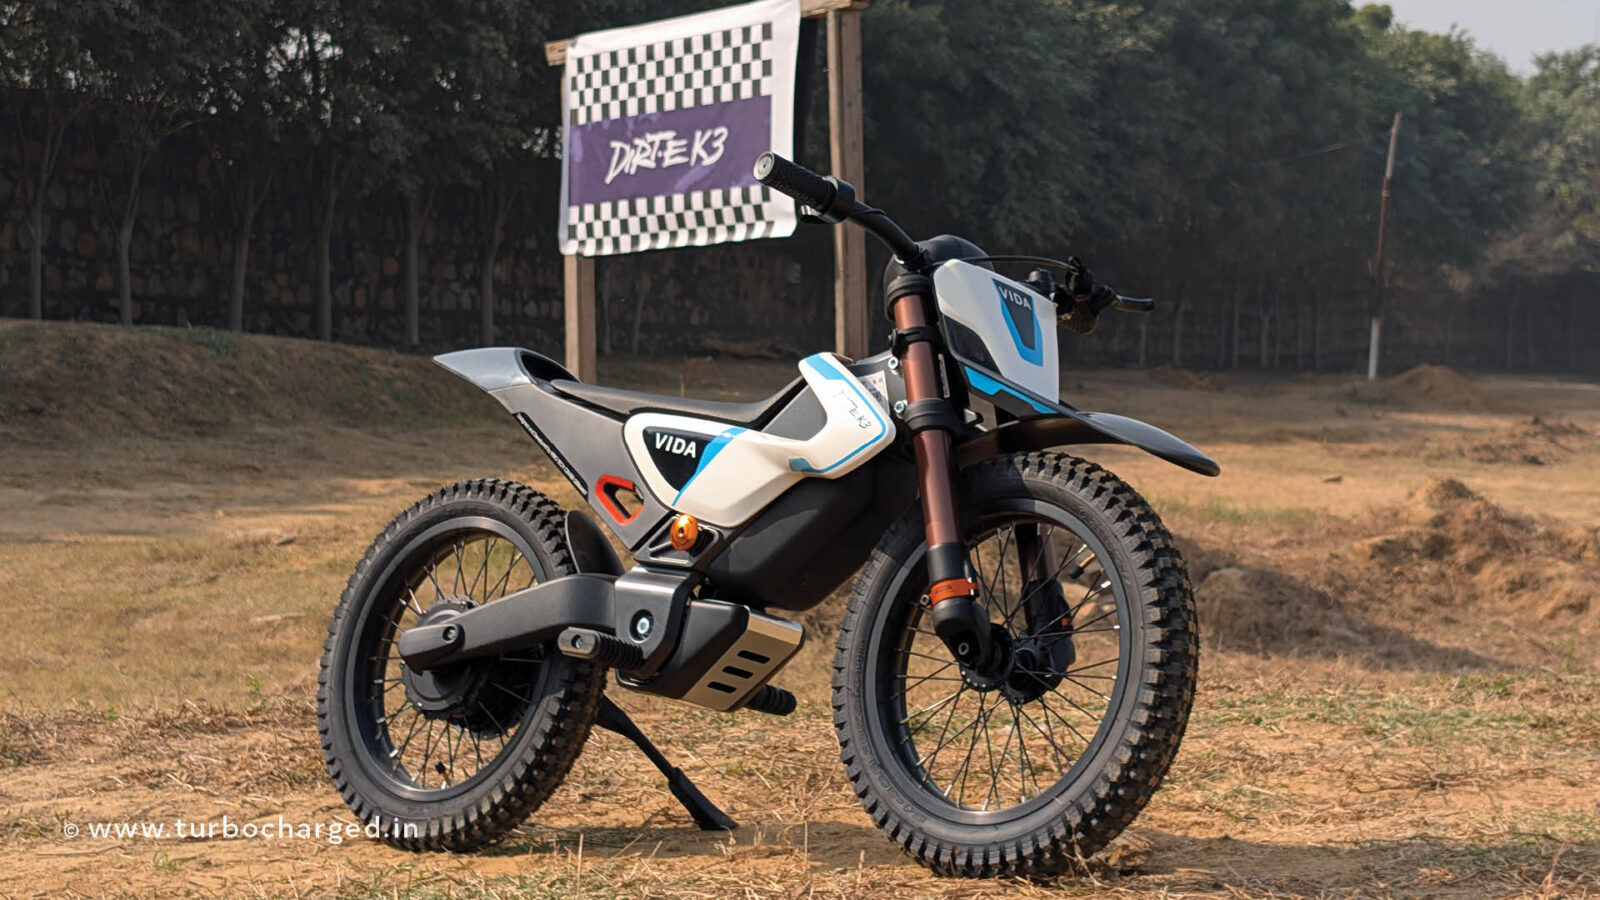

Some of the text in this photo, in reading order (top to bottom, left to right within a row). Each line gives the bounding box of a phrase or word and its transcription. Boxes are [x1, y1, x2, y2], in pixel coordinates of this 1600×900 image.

[690, 126, 729, 167] K3
[998, 285, 1032, 311] VIDA
[655, 433, 697, 459] VIDA
